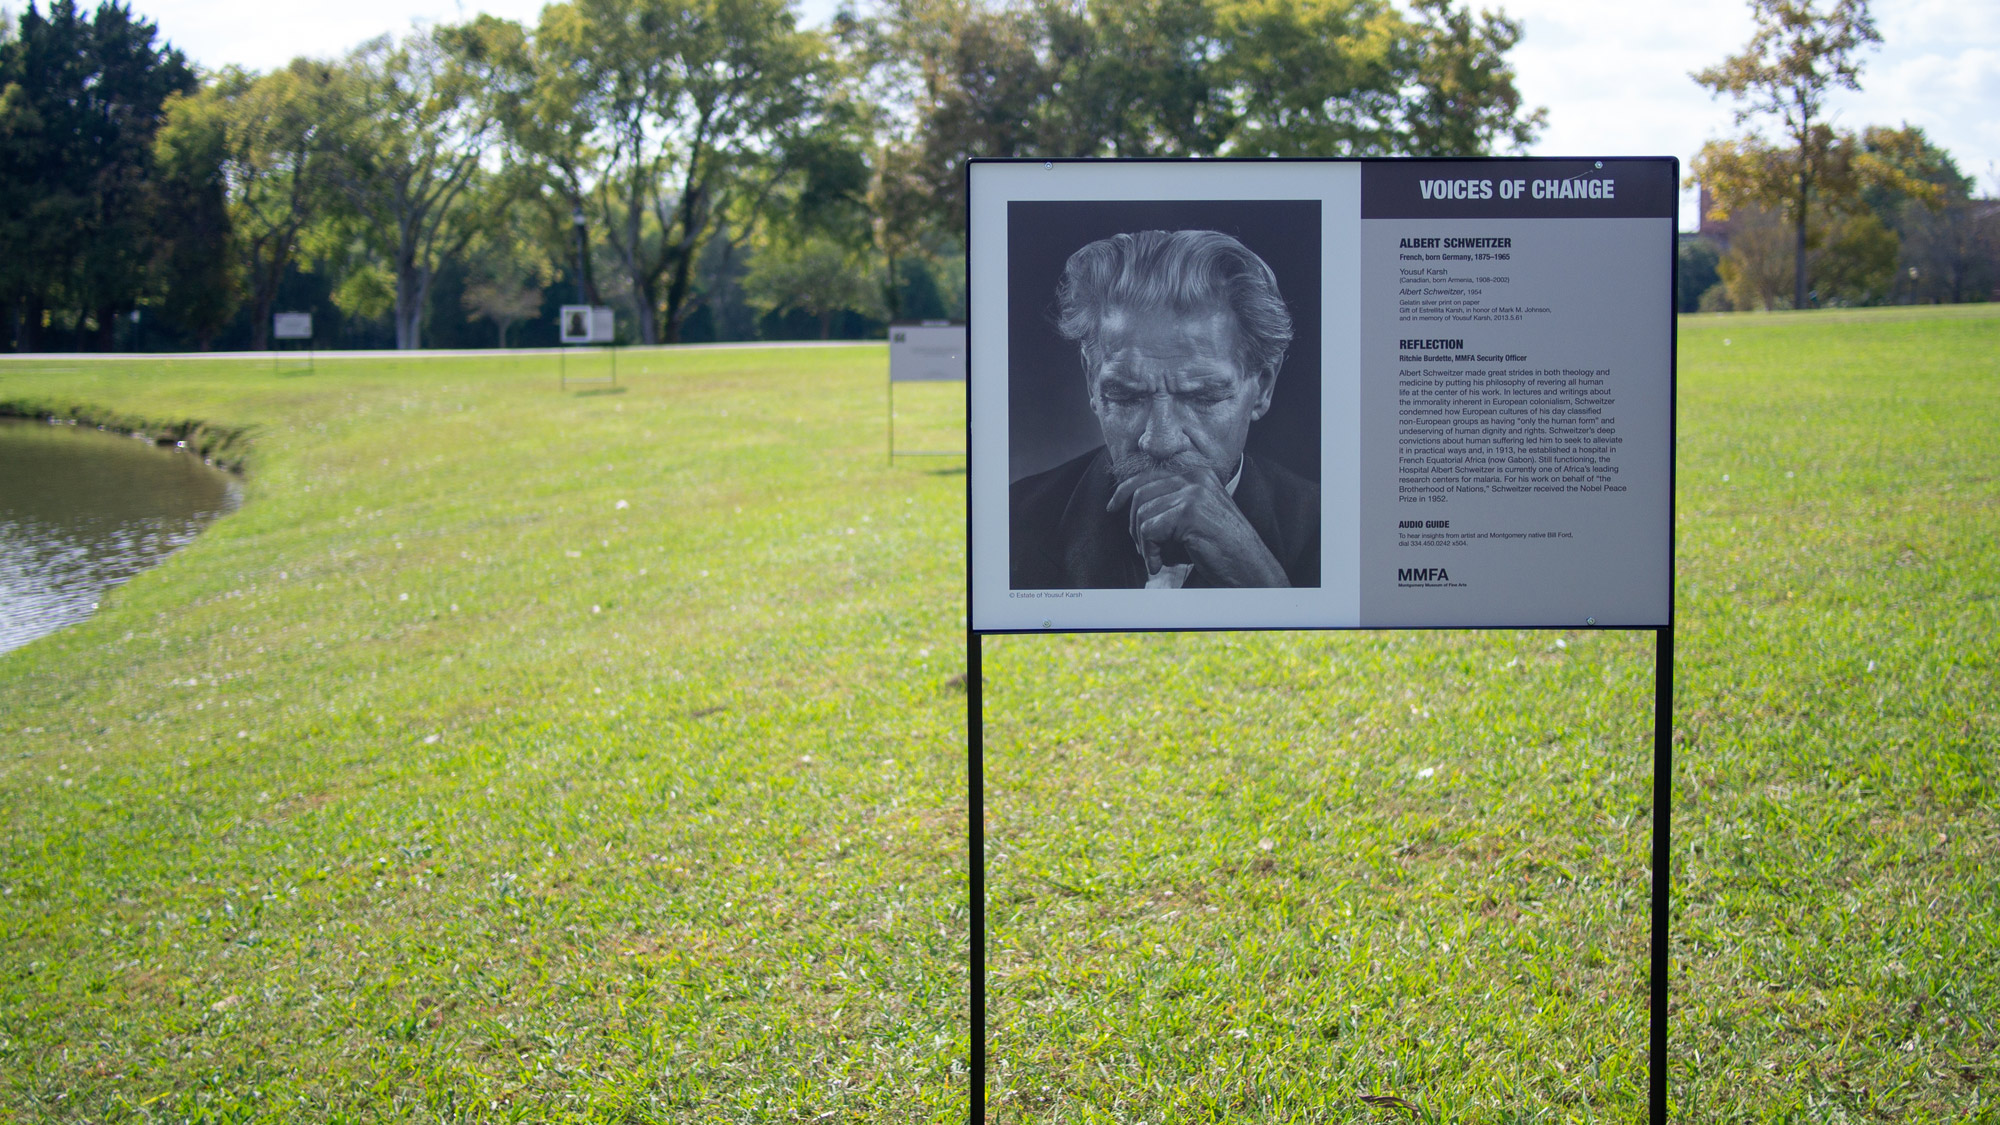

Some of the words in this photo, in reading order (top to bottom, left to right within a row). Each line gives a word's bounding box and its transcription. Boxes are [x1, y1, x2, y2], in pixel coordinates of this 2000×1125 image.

[1419, 180, 1493, 199] VOICES
[1499, 180, 1526, 199] OF
[1531, 179, 1615, 199] CHANGE
[1400, 238, 1440, 248] ALBERT
[1444, 238, 1511, 248] SCHWEITZER
[1442, 253, 1473, 261] Germany,
[1423, 288, 1465, 296] Schweitzer,
[1399, 339, 1464, 349] REFLECTION
[1562, 369, 1595, 377] theology
[1434, 379, 1444, 387] by
[1445, 379, 1471, 387] putting
[1485, 379, 1526, 387] philosophy
[1537, 379, 1567, 387] revering
[1492, 398, 1528, 406] European
[1462, 408, 1498, 416] European
[1551, 408, 1566, 416] day
[1567, 407, 1602, 415] classified
[1399, 418, 1451, 426] non-European
[1490, 418, 1516, 426] having
[1524, 427, 1547, 435] rights.
[1596, 427, 1616, 435] deep
[1487, 456, 1506, 464] (now
[1507, 456, 1537, 464] Gabon).
[1554, 456, 1597, 464] functioning,
[1504, 466, 1537, 474] currently
[1592, 465, 1619, 474] leading
[1425, 520, 1450, 528] GUIDE
[1398, 568, 1449, 581] MMFA
